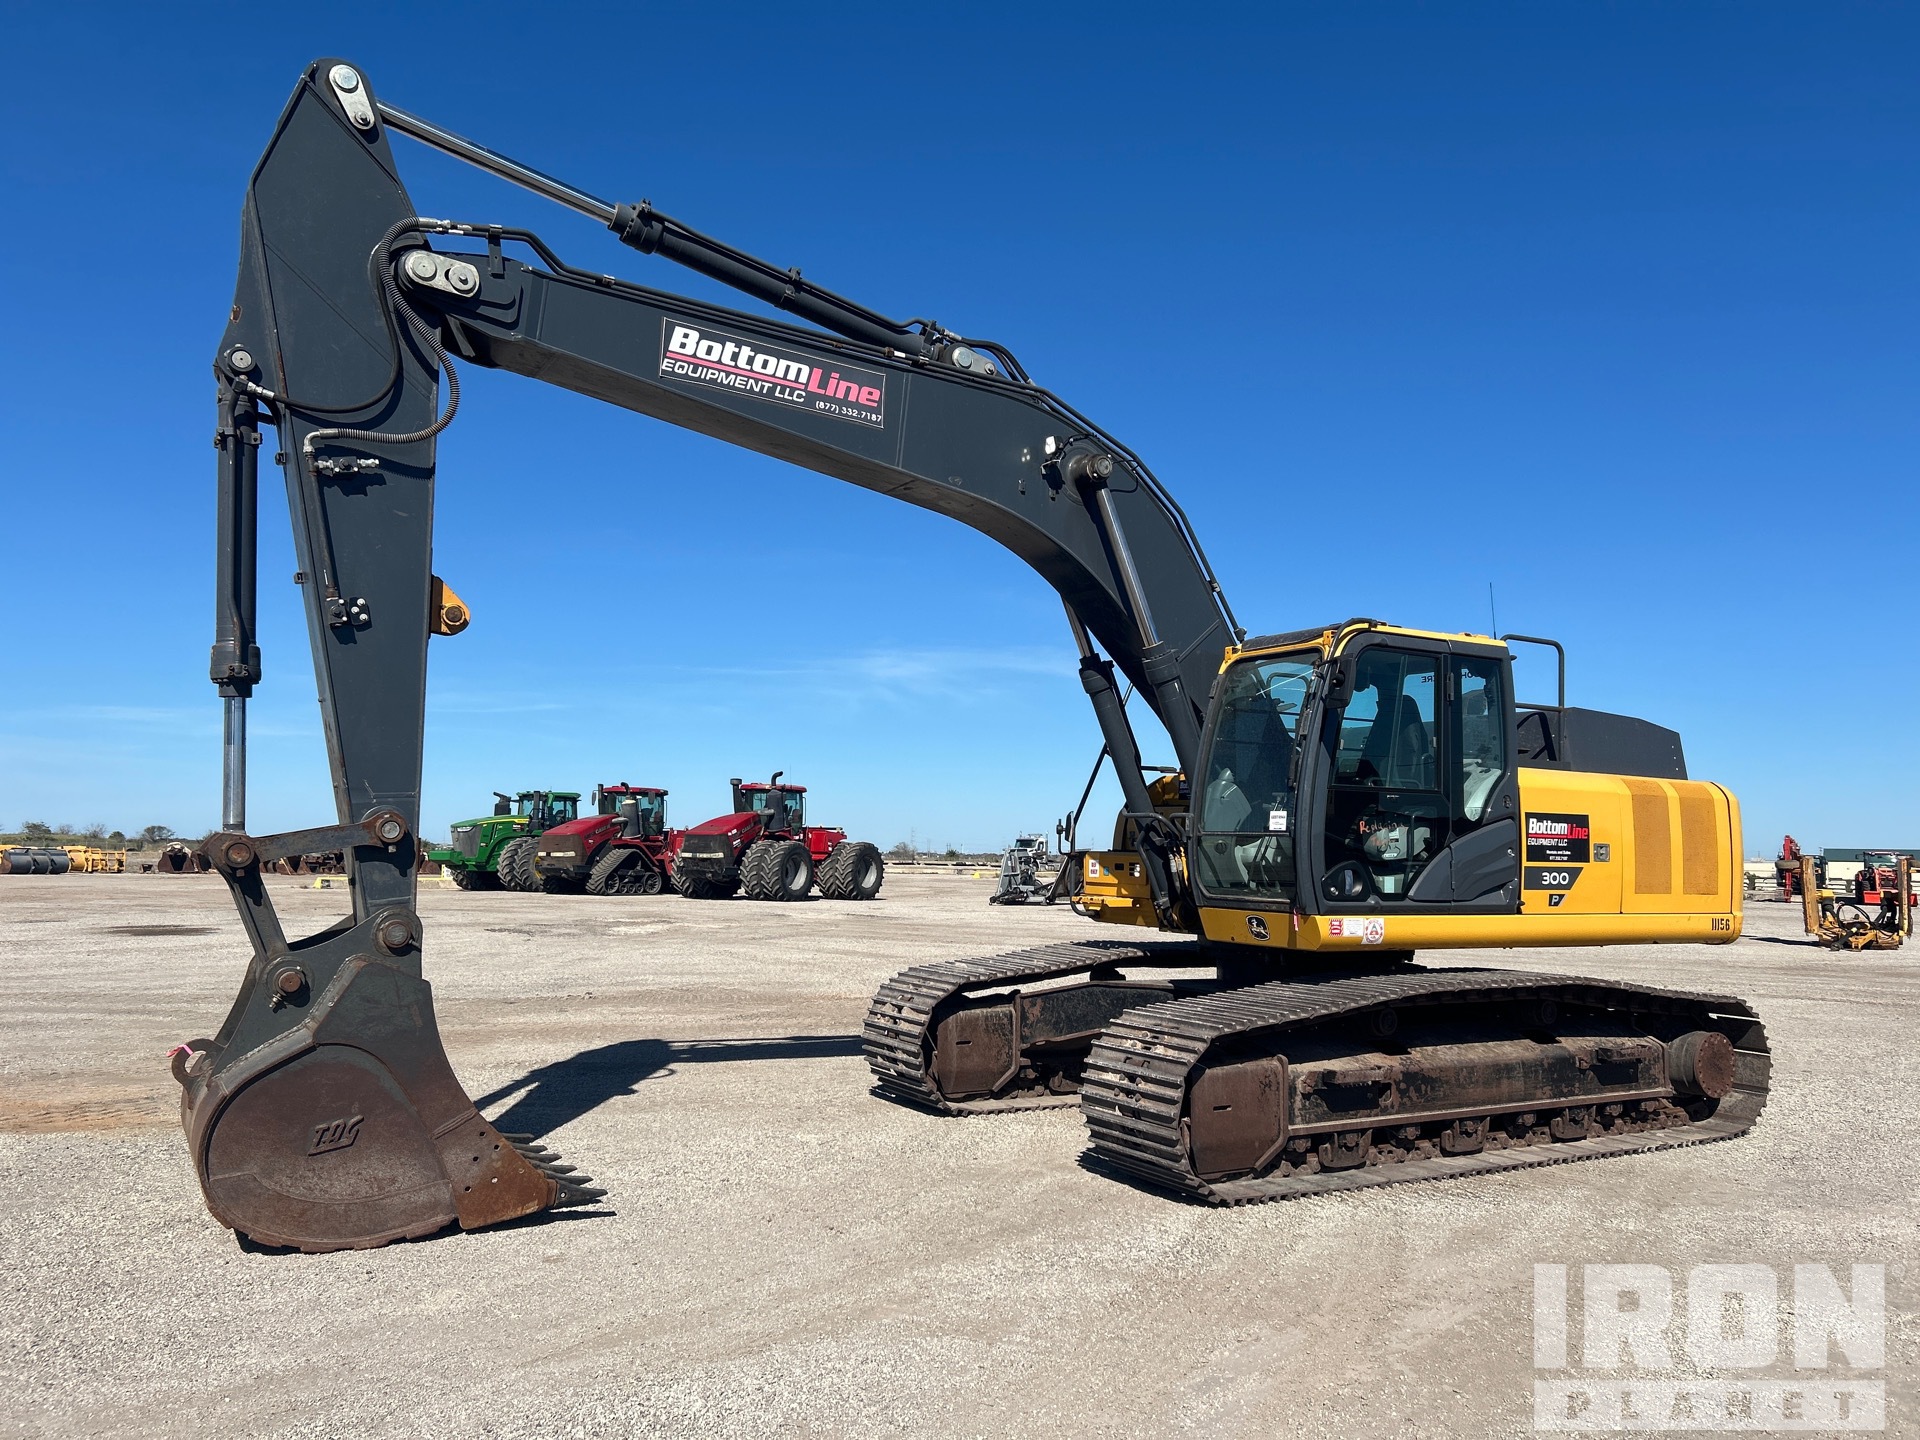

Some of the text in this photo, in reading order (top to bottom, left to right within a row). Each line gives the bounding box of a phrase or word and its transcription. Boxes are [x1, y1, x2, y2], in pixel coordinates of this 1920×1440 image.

[661, 358, 806, 403] EQUIPMENT LLC
[815, 400, 882, 422] (877) 332.7187
[1527, 838, 1568, 847] EQUIPMENT LLC
[1541, 872, 1569, 885] 300
[1551, 895, 1560, 905] P
[1711, 918, 1730, 931] 11156
